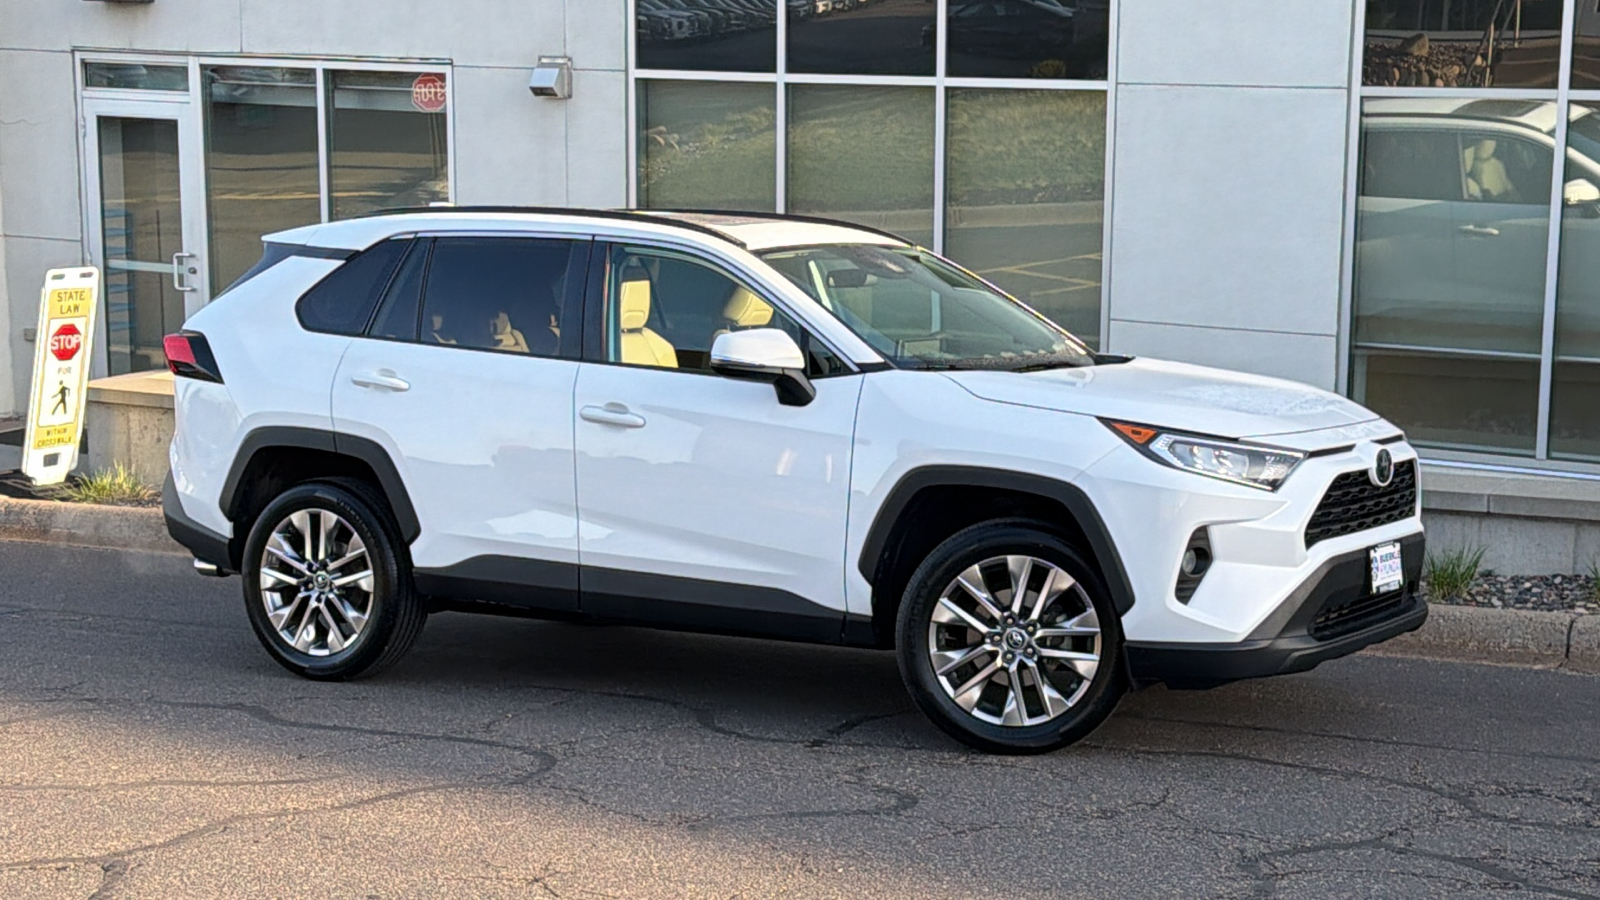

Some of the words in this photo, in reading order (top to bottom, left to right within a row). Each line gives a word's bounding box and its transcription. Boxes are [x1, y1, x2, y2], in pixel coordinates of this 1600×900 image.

[57, 290, 85, 302] STATE
[60, 304, 80, 314] LAW
[51, 334, 82, 350] STOP
[37, 436, 71, 447] CROSSWALK
